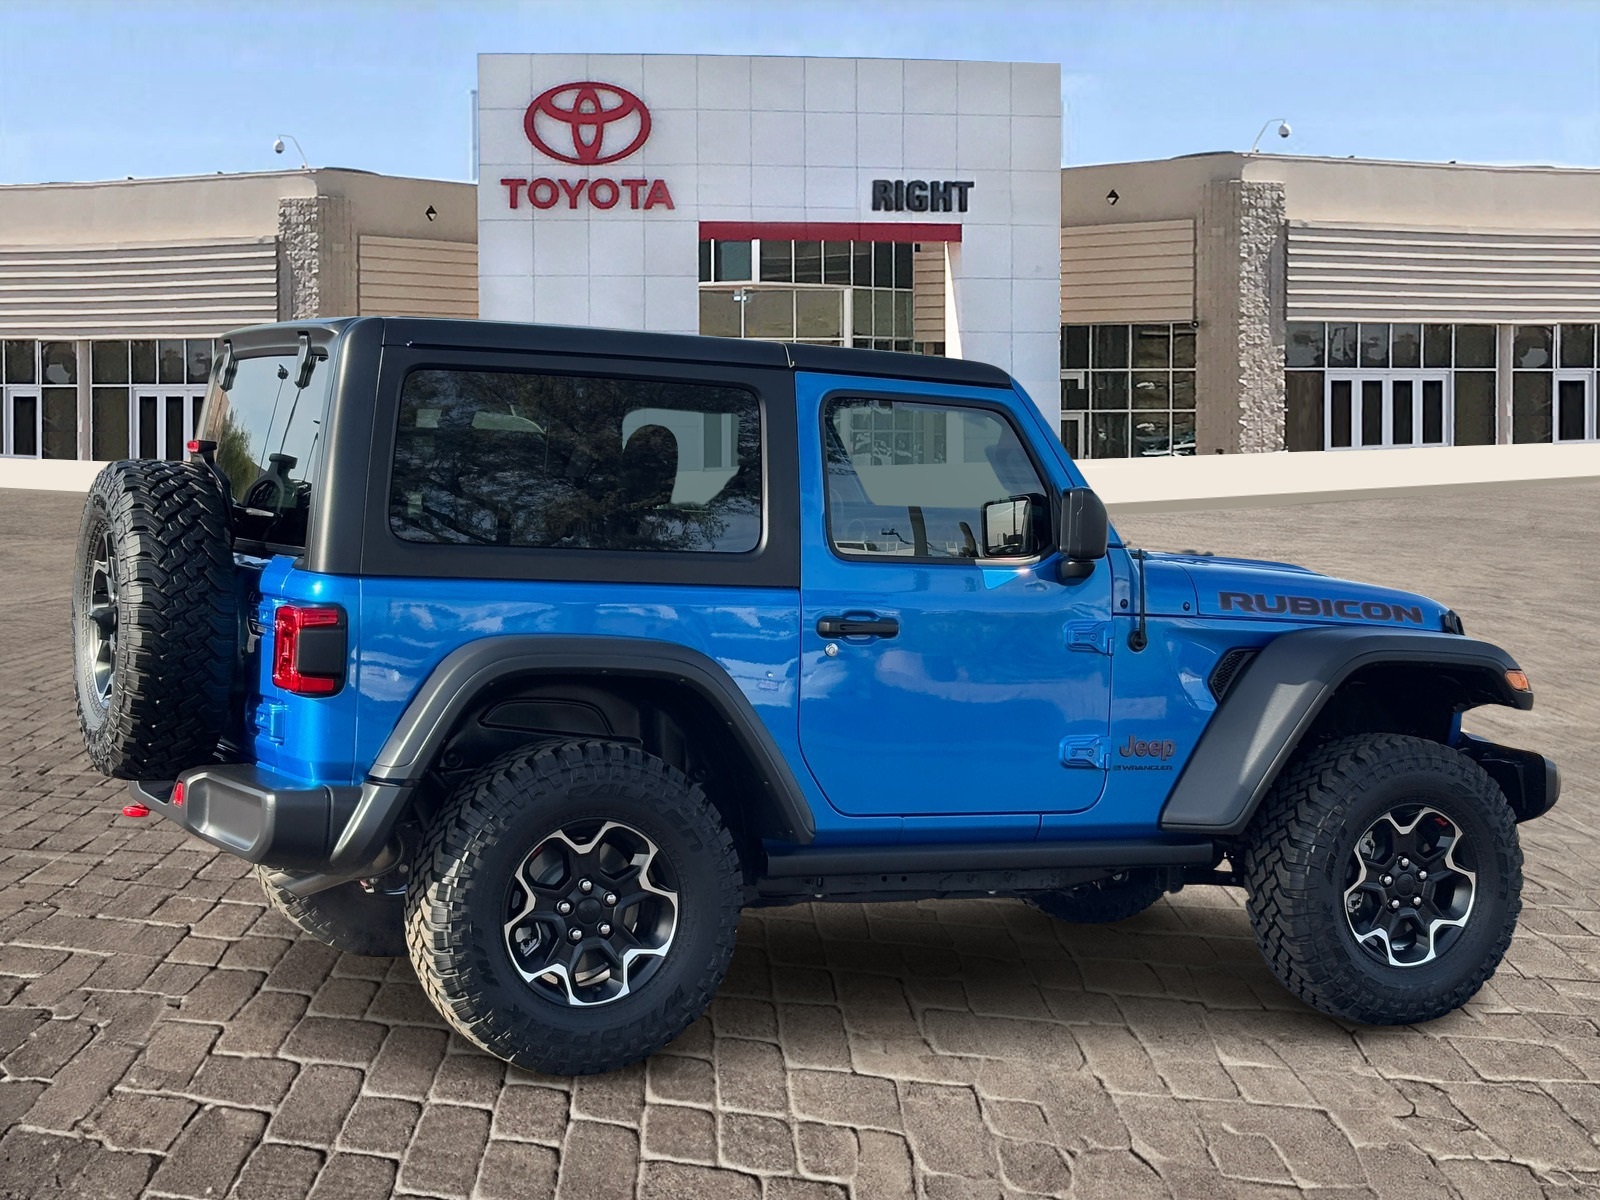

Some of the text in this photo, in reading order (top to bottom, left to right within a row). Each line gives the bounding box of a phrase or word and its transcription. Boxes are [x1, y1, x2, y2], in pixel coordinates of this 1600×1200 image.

[500, 178, 675, 210] TOYOTA
[871, 179, 974, 213] RIGHT
[1219, 592, 1424, 624] RUBICON
[1119, 735, 1175, 761] Jeep
